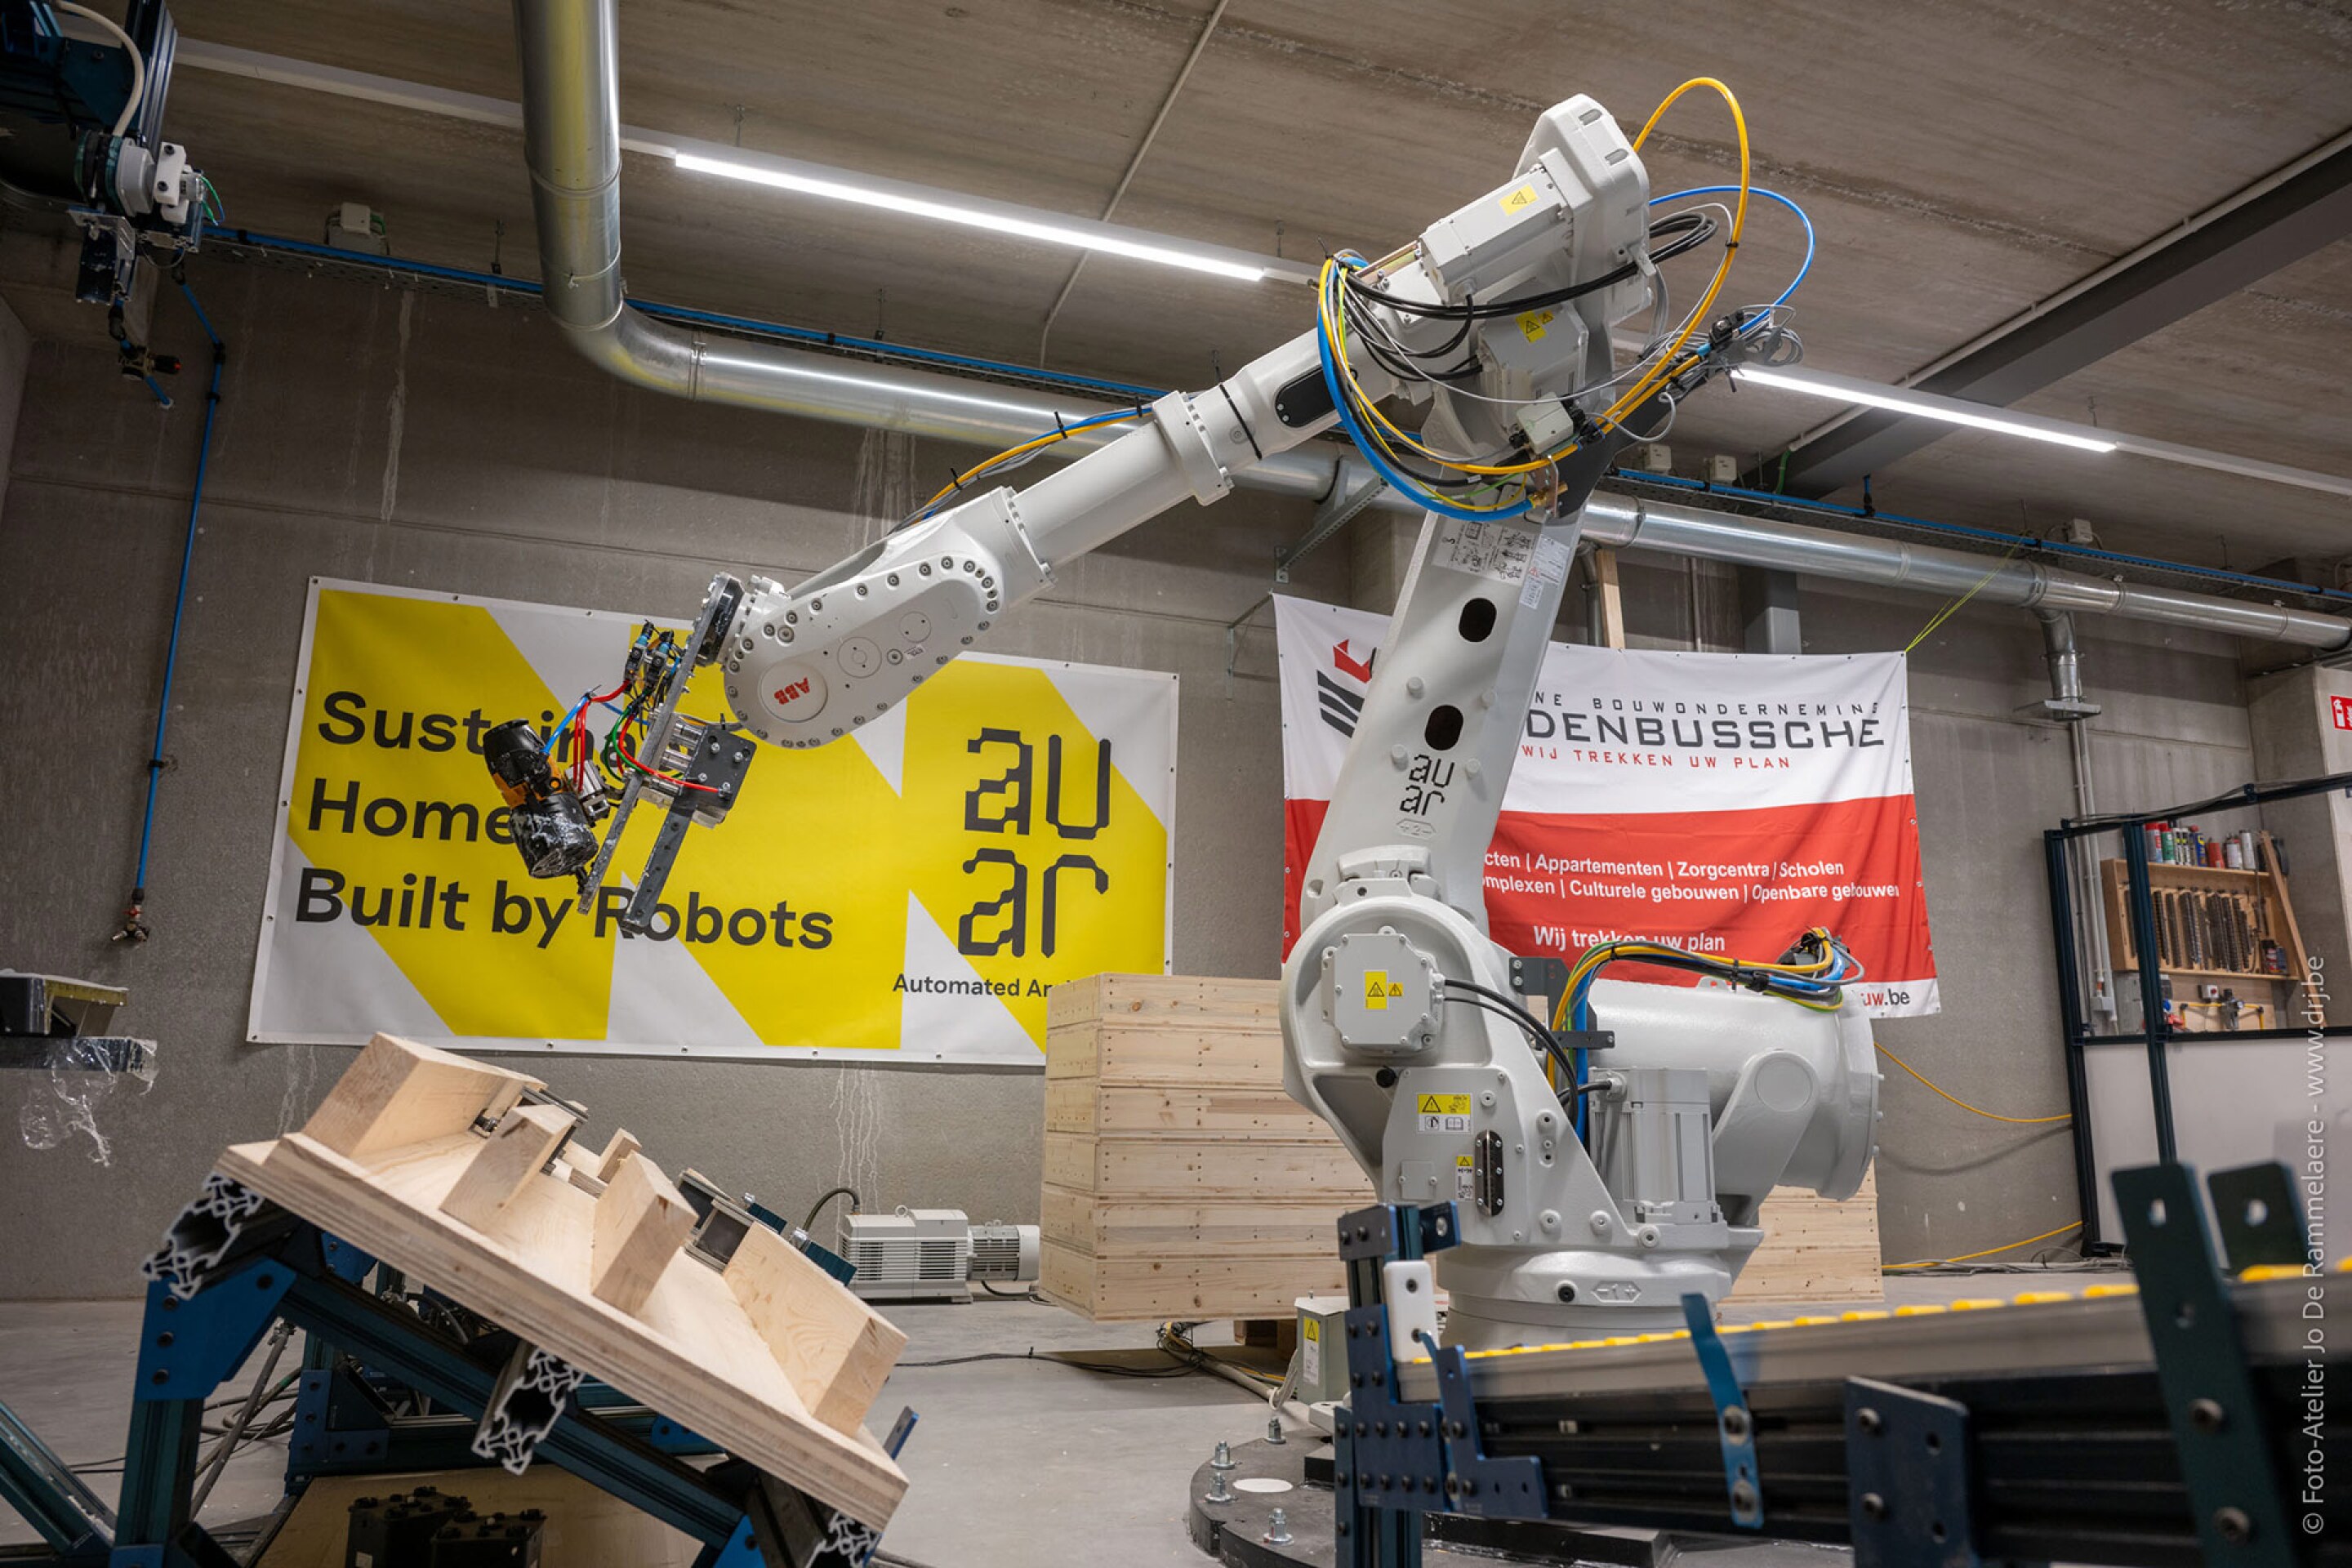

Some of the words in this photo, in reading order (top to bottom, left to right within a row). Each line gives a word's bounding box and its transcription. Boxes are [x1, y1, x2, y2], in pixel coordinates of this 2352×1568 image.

[774, 678, 809, 705] ABB
[1526, 709, 1884, 750] DENBUSSCHE
[1408, 754, 1455, 788] au
[1521, 745, 1557, 760] WIJ
[1573, 750, 1673, 766] TREKKEN
[1690, 756, 1717, 768] UW
[1734, 756, 1790, 768] PLAN
[964, 726, 1111, 840] au
[1399, 784, 1446, 816] ar
[1535, 854, 1664, 876] Appartementen
[1677, 861, 1771, 881] Zorgcentra
[1779, 860, 1844, 878] Scholen
[958, 847, 1110, 959] ar
[1481, 875, 1556, 897] mplexen
[1570, 879, 1646, 899] Culturele
[1650, 884, 1740, 903] gebouwen
[1752, 884, 1829, 904] Openbare
[295, 866, 469, 929] Built
[492, 880, 573, 950] by
[595, 886, 834, 951] Robots
[1533, 925, 1566, 951] Wij
[1688, 933, 1726, 952] plan
[892, 973, 1020, 997] Automated
